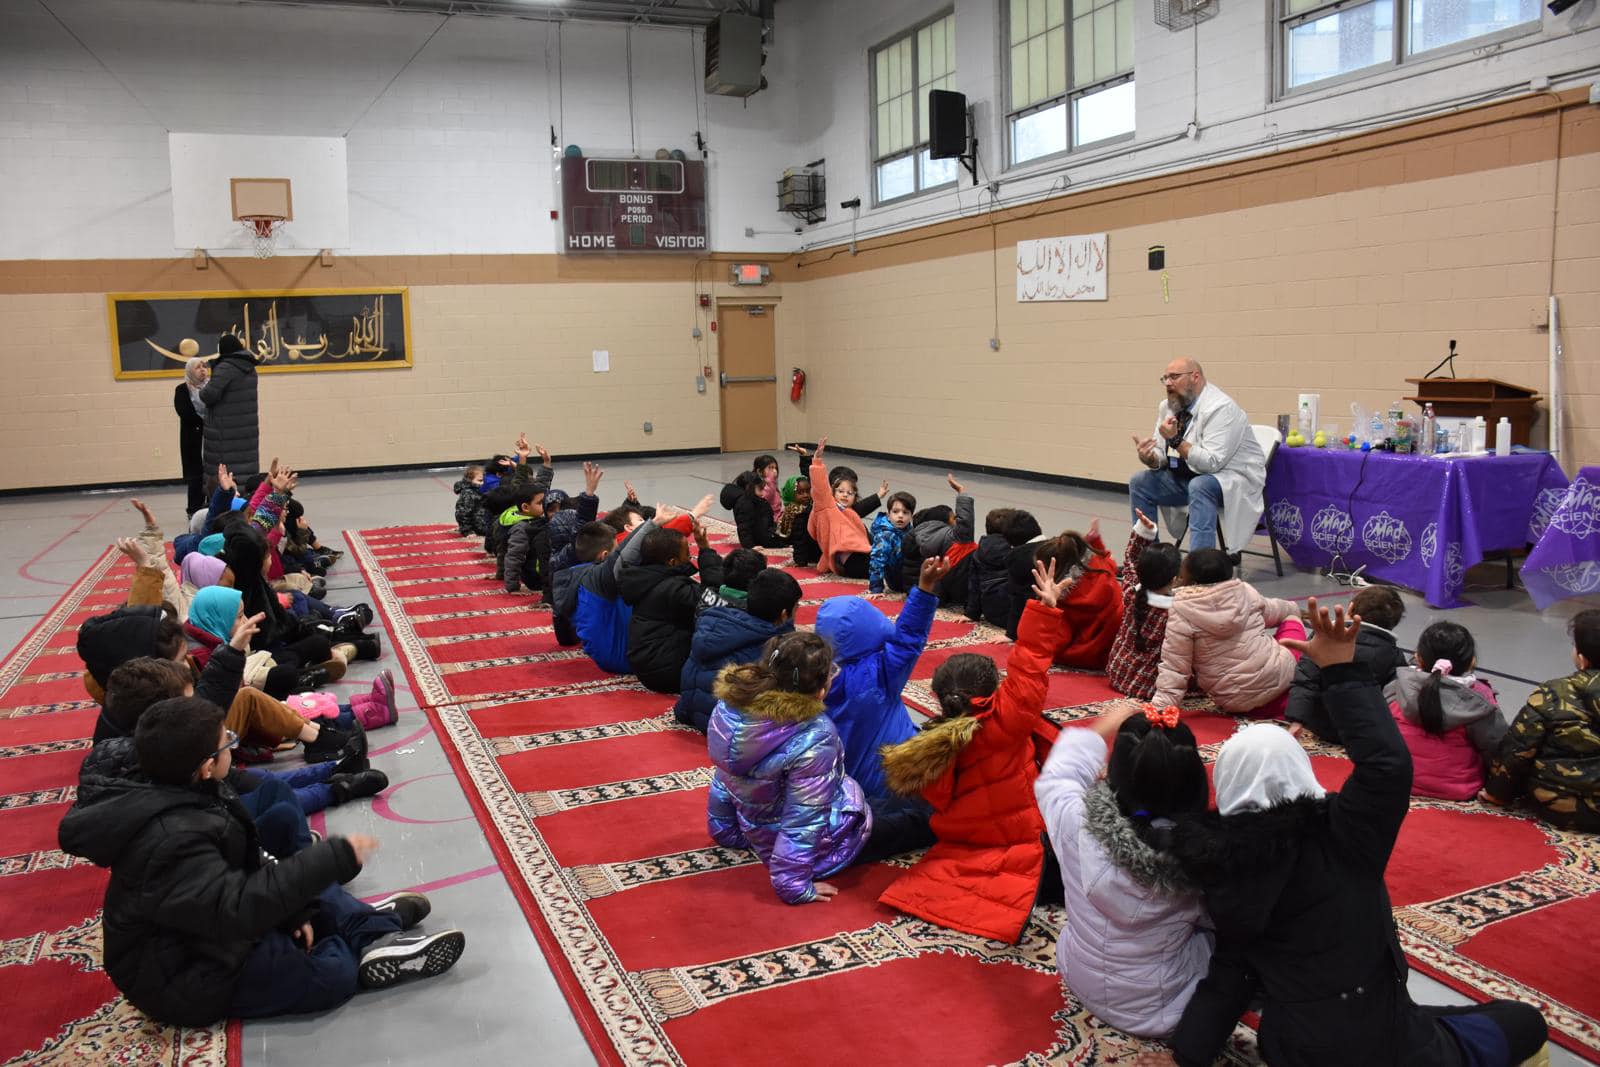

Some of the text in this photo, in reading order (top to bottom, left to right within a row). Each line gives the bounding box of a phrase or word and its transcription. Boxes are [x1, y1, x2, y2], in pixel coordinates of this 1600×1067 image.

[619, 195, 654, 204] BONUS
[627, 206, 646, 214] POSS
[621, 215, 653, 224] PERIOD
[569, 235, 616, 248] HOME
[655, 236, 705, 248] VISITOR
[1312, 531, 1353, 545] SCIENCE
[1364, 538, 1412, 551] SCIENCE
